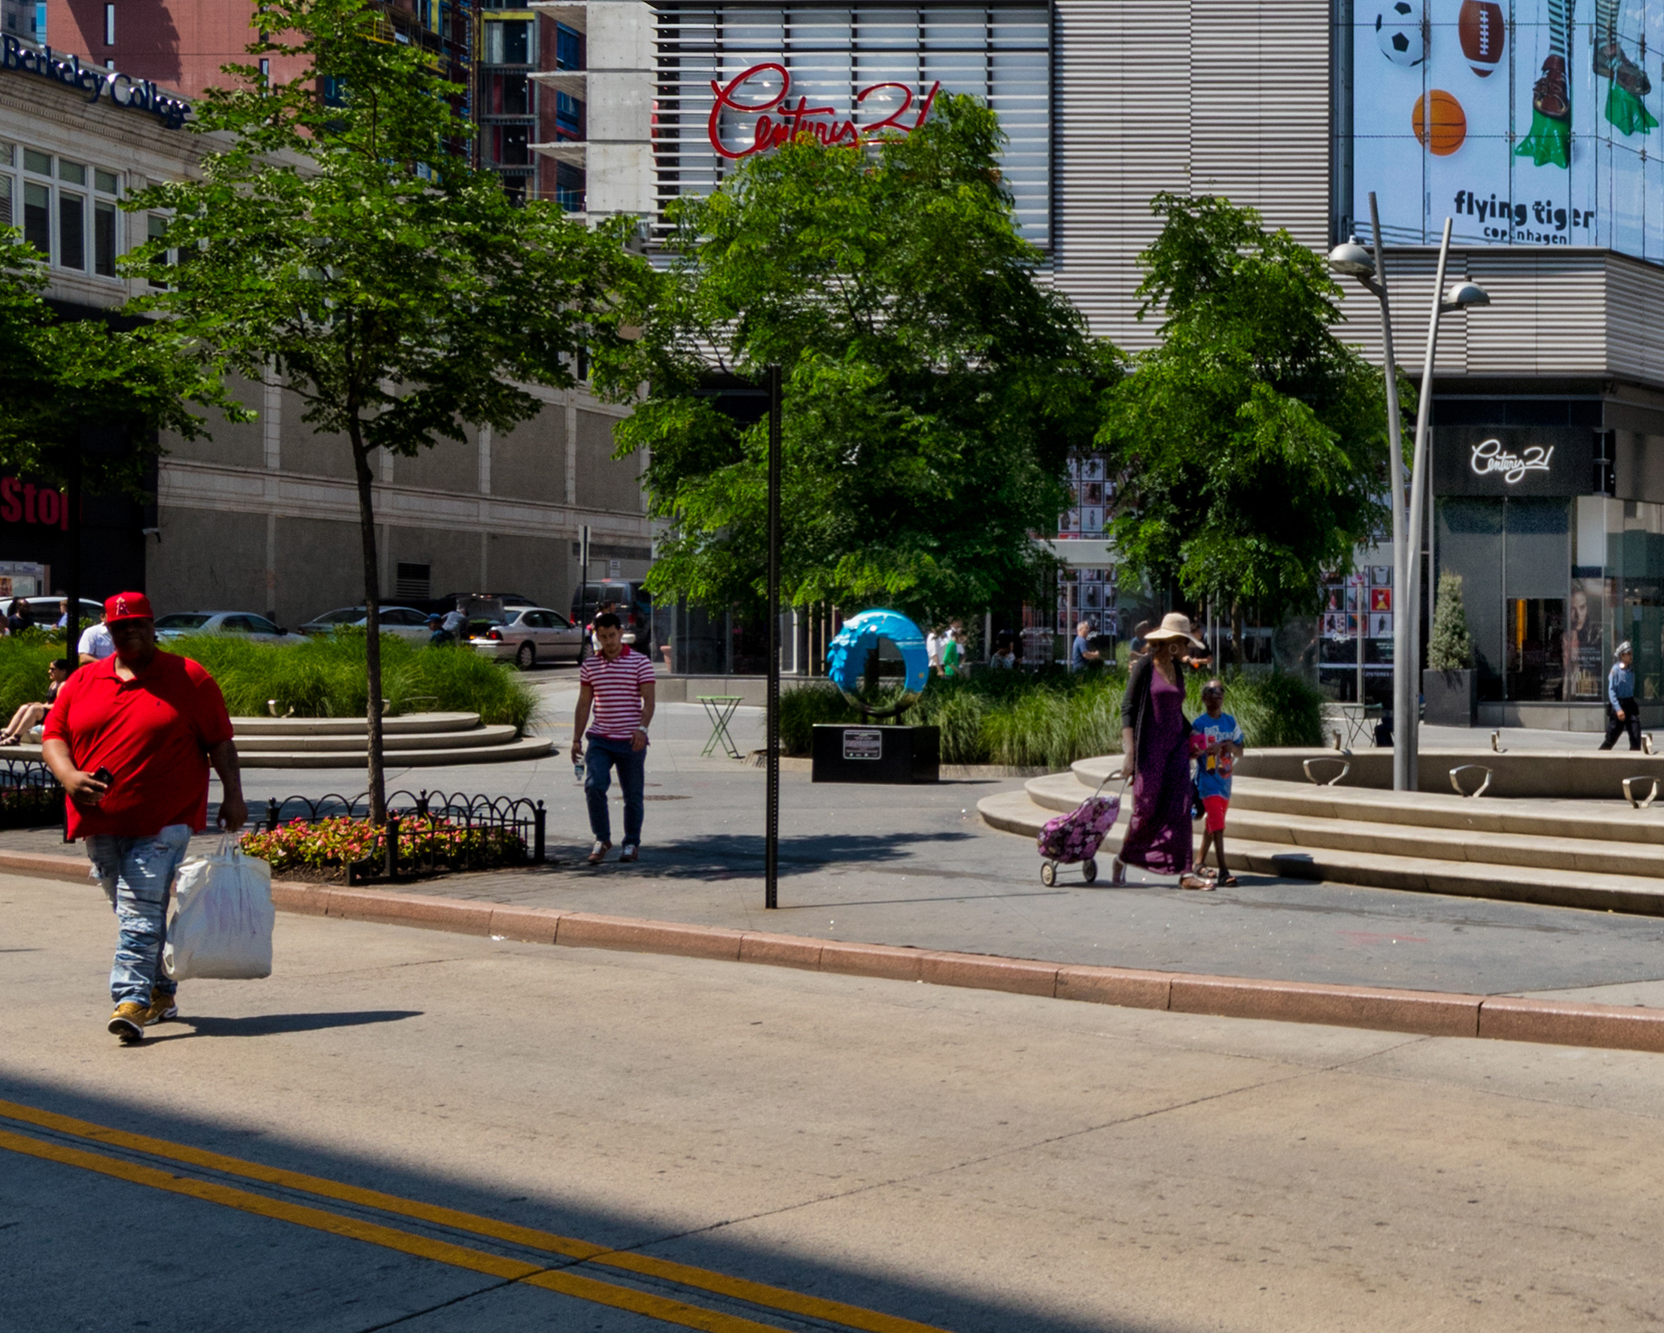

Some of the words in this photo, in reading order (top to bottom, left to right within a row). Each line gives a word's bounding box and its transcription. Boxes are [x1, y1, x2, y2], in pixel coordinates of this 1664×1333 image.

[2, 35, 107, 104] Berkeley
[107, 72, 191, 130] College
[1454, 190, 1527, 227] flying
[1532, 199, 1595, 231] tiger
[1484, 226, 1567, 245] copnhagen
[1471, 438, 1525, 484] Century
